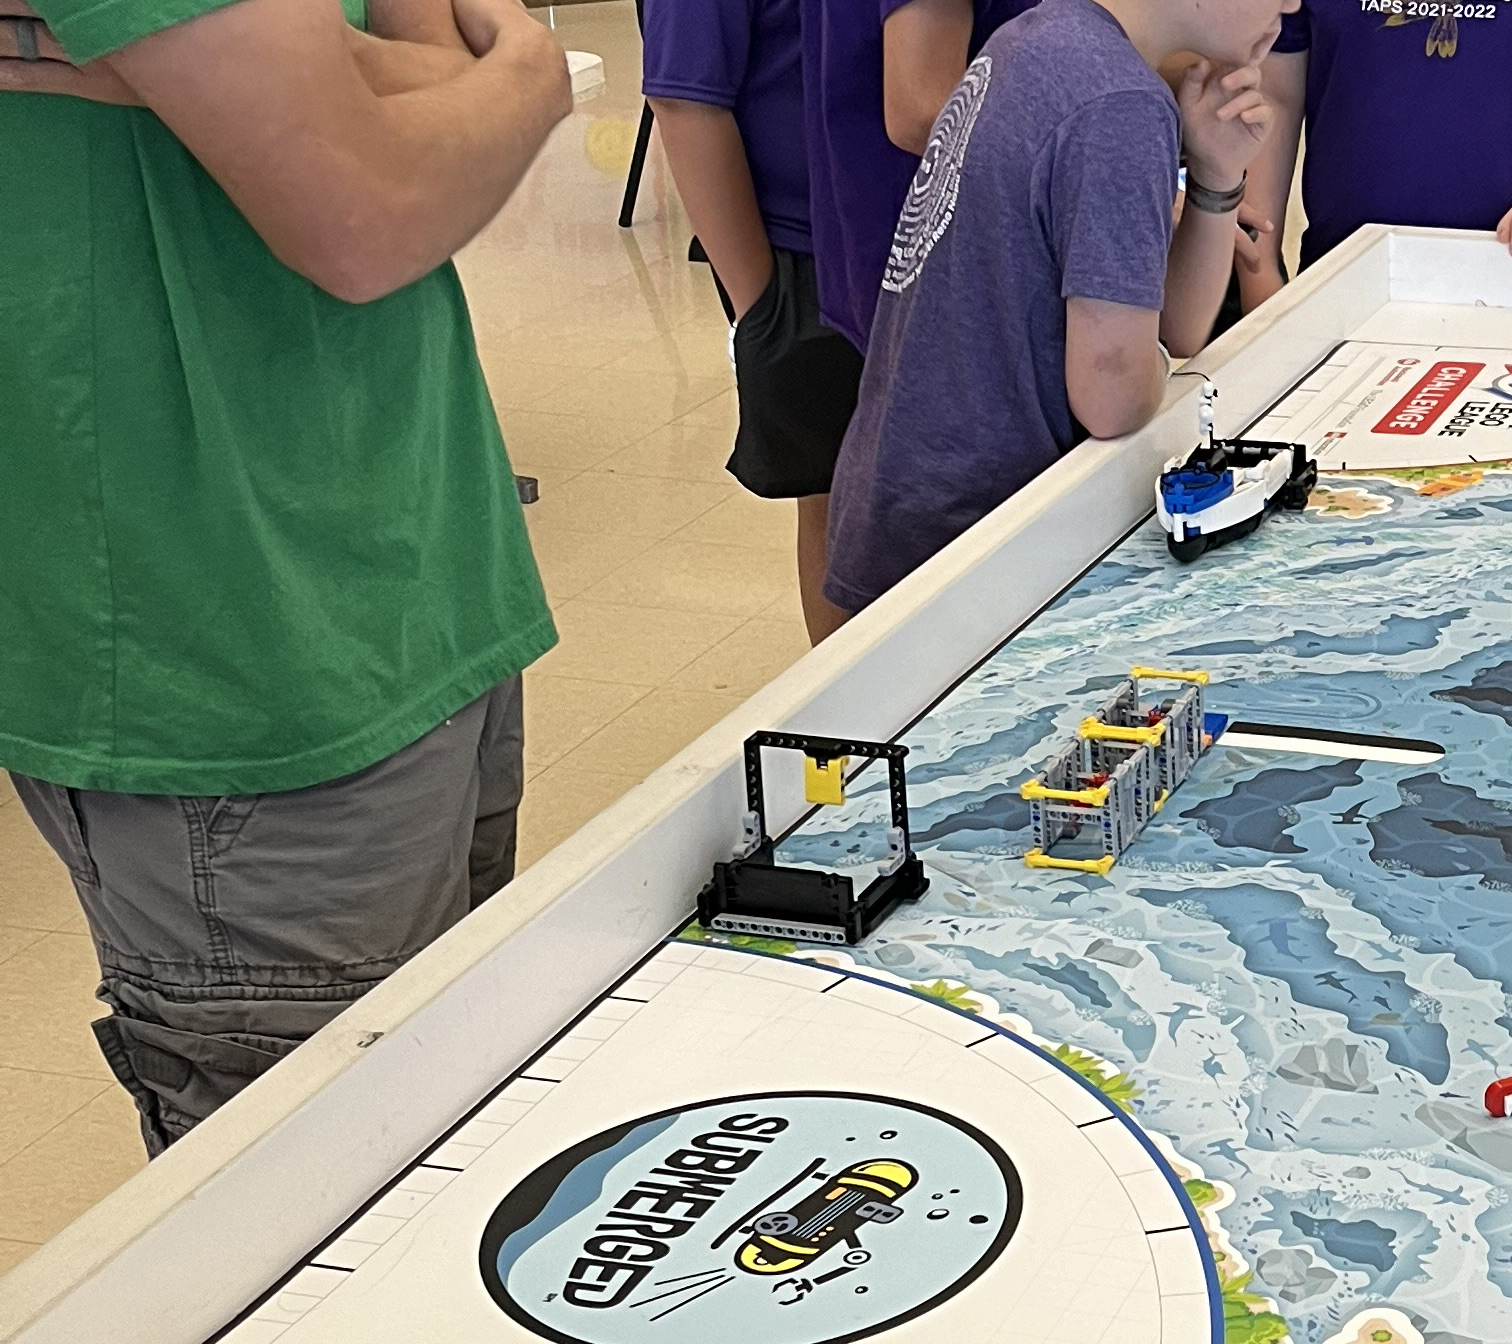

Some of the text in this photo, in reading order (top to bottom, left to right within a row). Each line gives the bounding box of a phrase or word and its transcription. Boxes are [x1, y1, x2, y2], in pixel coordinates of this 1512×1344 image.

[1406, 2, 1497, 19] 2021-2022
[1388, 366, 1468, 430] CHALLENGE
[1437, 400, 1491, 438] LEAGUE
[562, 1112, 790, 1309] SUBMERGED
